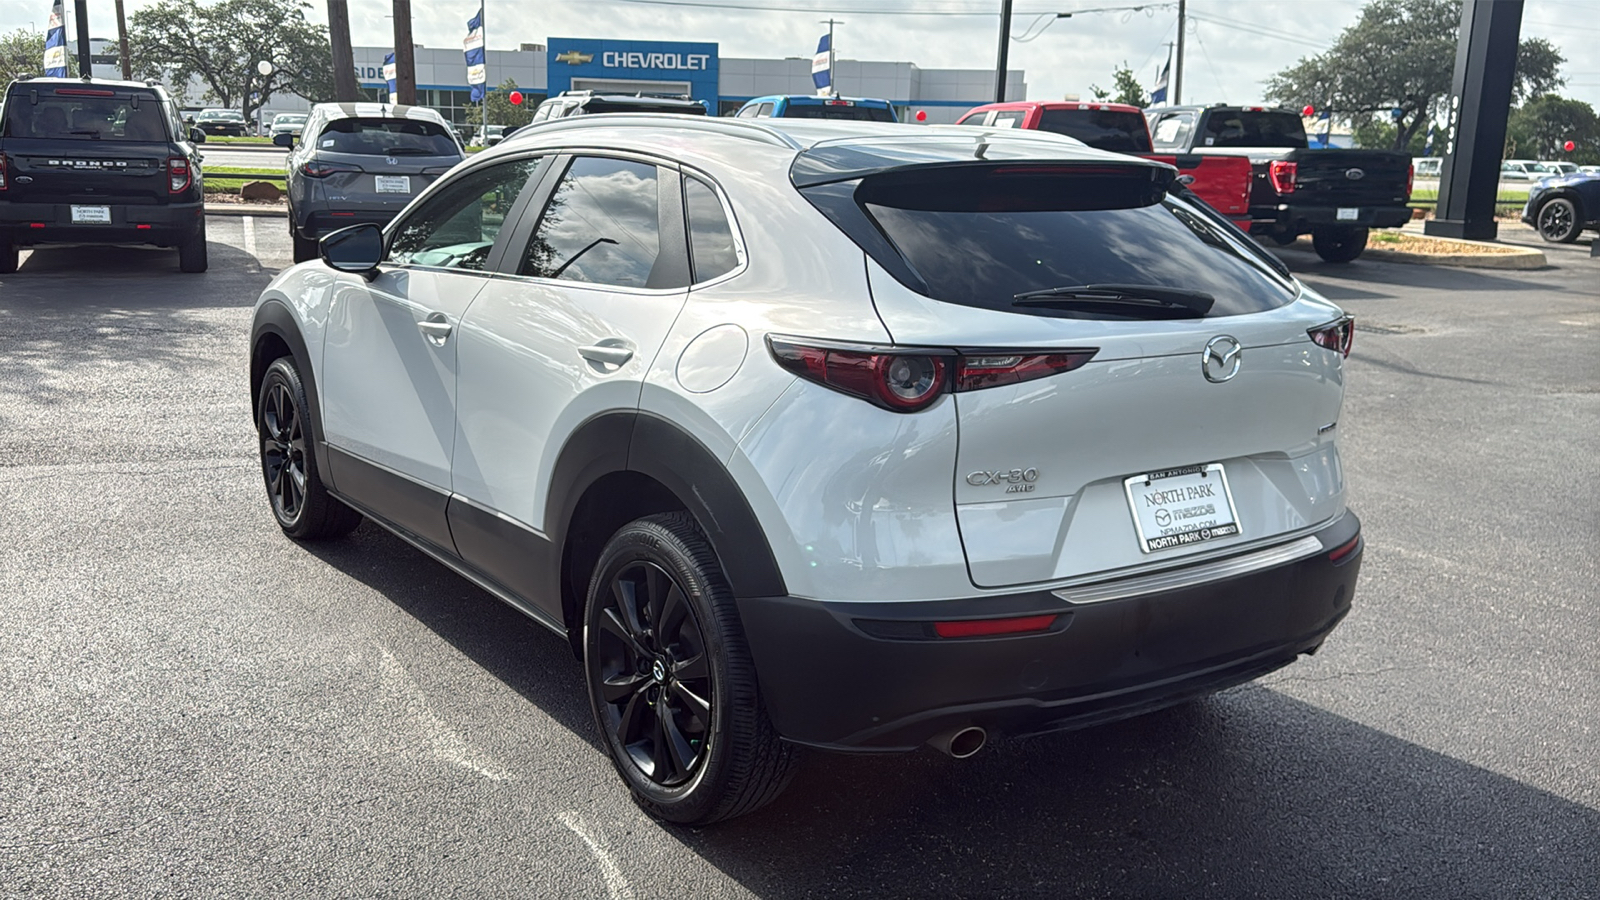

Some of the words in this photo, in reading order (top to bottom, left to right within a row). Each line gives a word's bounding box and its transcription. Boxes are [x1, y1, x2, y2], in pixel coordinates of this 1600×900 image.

[603, 51, 710, 70] CHEVROLET
[966, 467, 1039, 486] CX-30
[1168, 467, 1201, 477] ANTONIO
[1006, 485, 1035, 494] AWD
[1144, 489, 1186, 507] NORTH
[1187, 483, 1216, 500] PARK
[1149, 536, 1179, 550] NORTH
[1179, 532, 1201, 544] PARK
